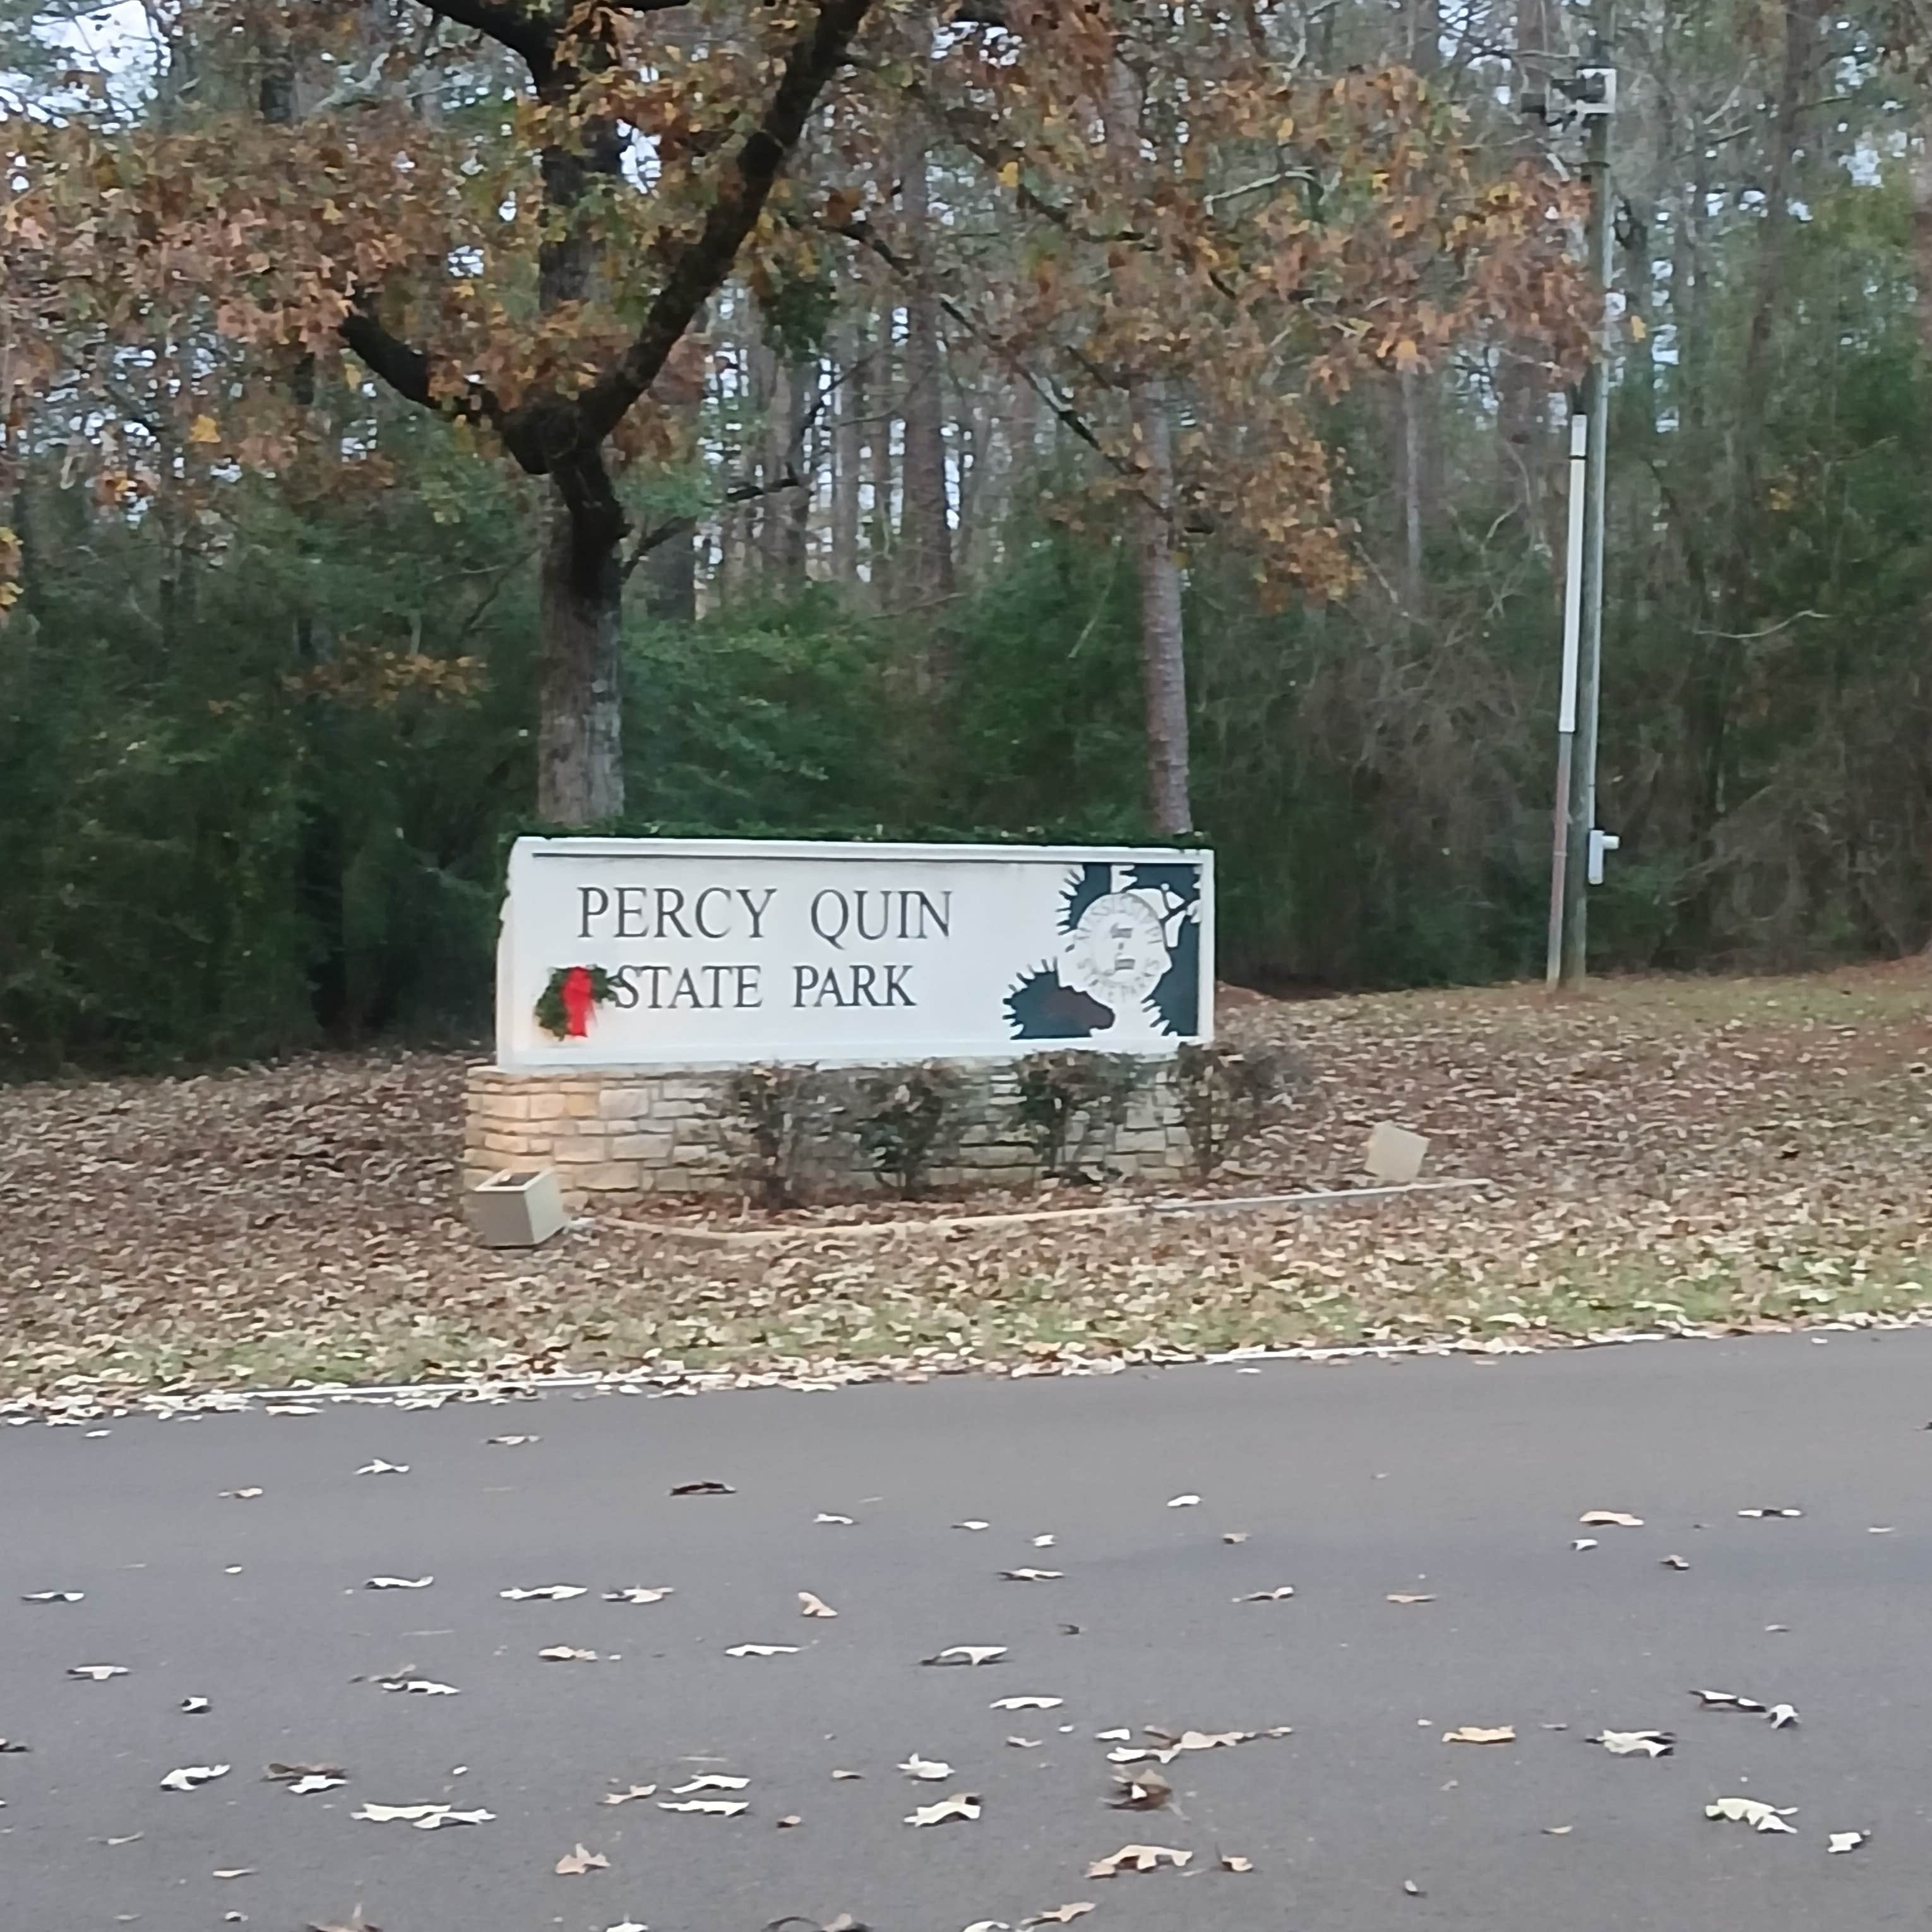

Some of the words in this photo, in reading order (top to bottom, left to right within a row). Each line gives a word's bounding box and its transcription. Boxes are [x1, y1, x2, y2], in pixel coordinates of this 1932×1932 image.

[577, 886, 777, 938] PERCY
[811, 888, 952, 950] QUIN
[614, 965, 763, 1009] STATE
[792, 965, 917, 1007] PARK
